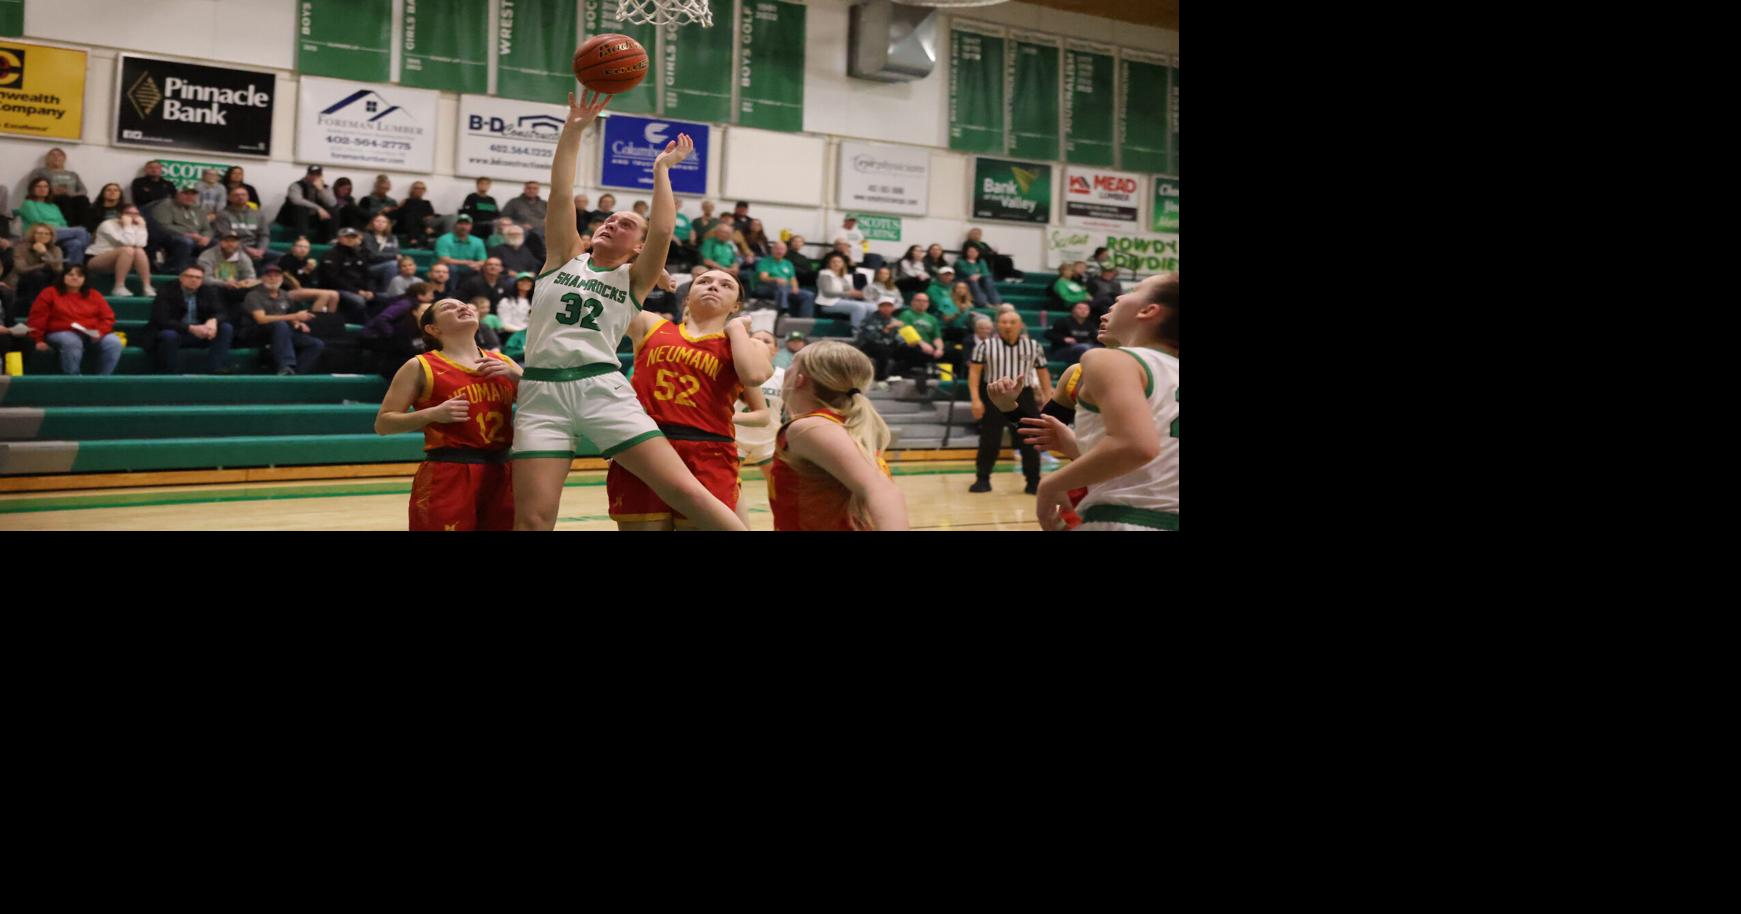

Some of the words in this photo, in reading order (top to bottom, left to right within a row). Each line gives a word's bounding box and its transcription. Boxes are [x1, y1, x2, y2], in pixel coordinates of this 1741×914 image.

[301, 2, 312, 35] BOYS
[405, 16, 416, 50] GIRLS
[742, 6, 753, 44] GOLF
[665, 45, 677, 86] GIRLS
[741, 48, 751, 88] BOYS
[164, 77, 269, 108] Pinnacle
[0, 103, 66, 120] ompany
[163, 99, 227, 126] Bank
[469, 114, 504, 133] B-D
[611, 140, 662, 156] Columb
[160, 162, 229, 179] SCOTS
[983, 177, 1018, 195] Bank
[1093, 174, 1137, 194] MEAD
[1000, 196, 1038, 214] Valley
[1106, 236, 1178, 254] ROWDY
[553, 271, 628, 304] SHAMROCKS
[555, 292, 604, 332] 32
[646, 345, 724, 381] NEUMANN
[653, 368, 701, 408] 52
[475, 411, 506, 444] 12
